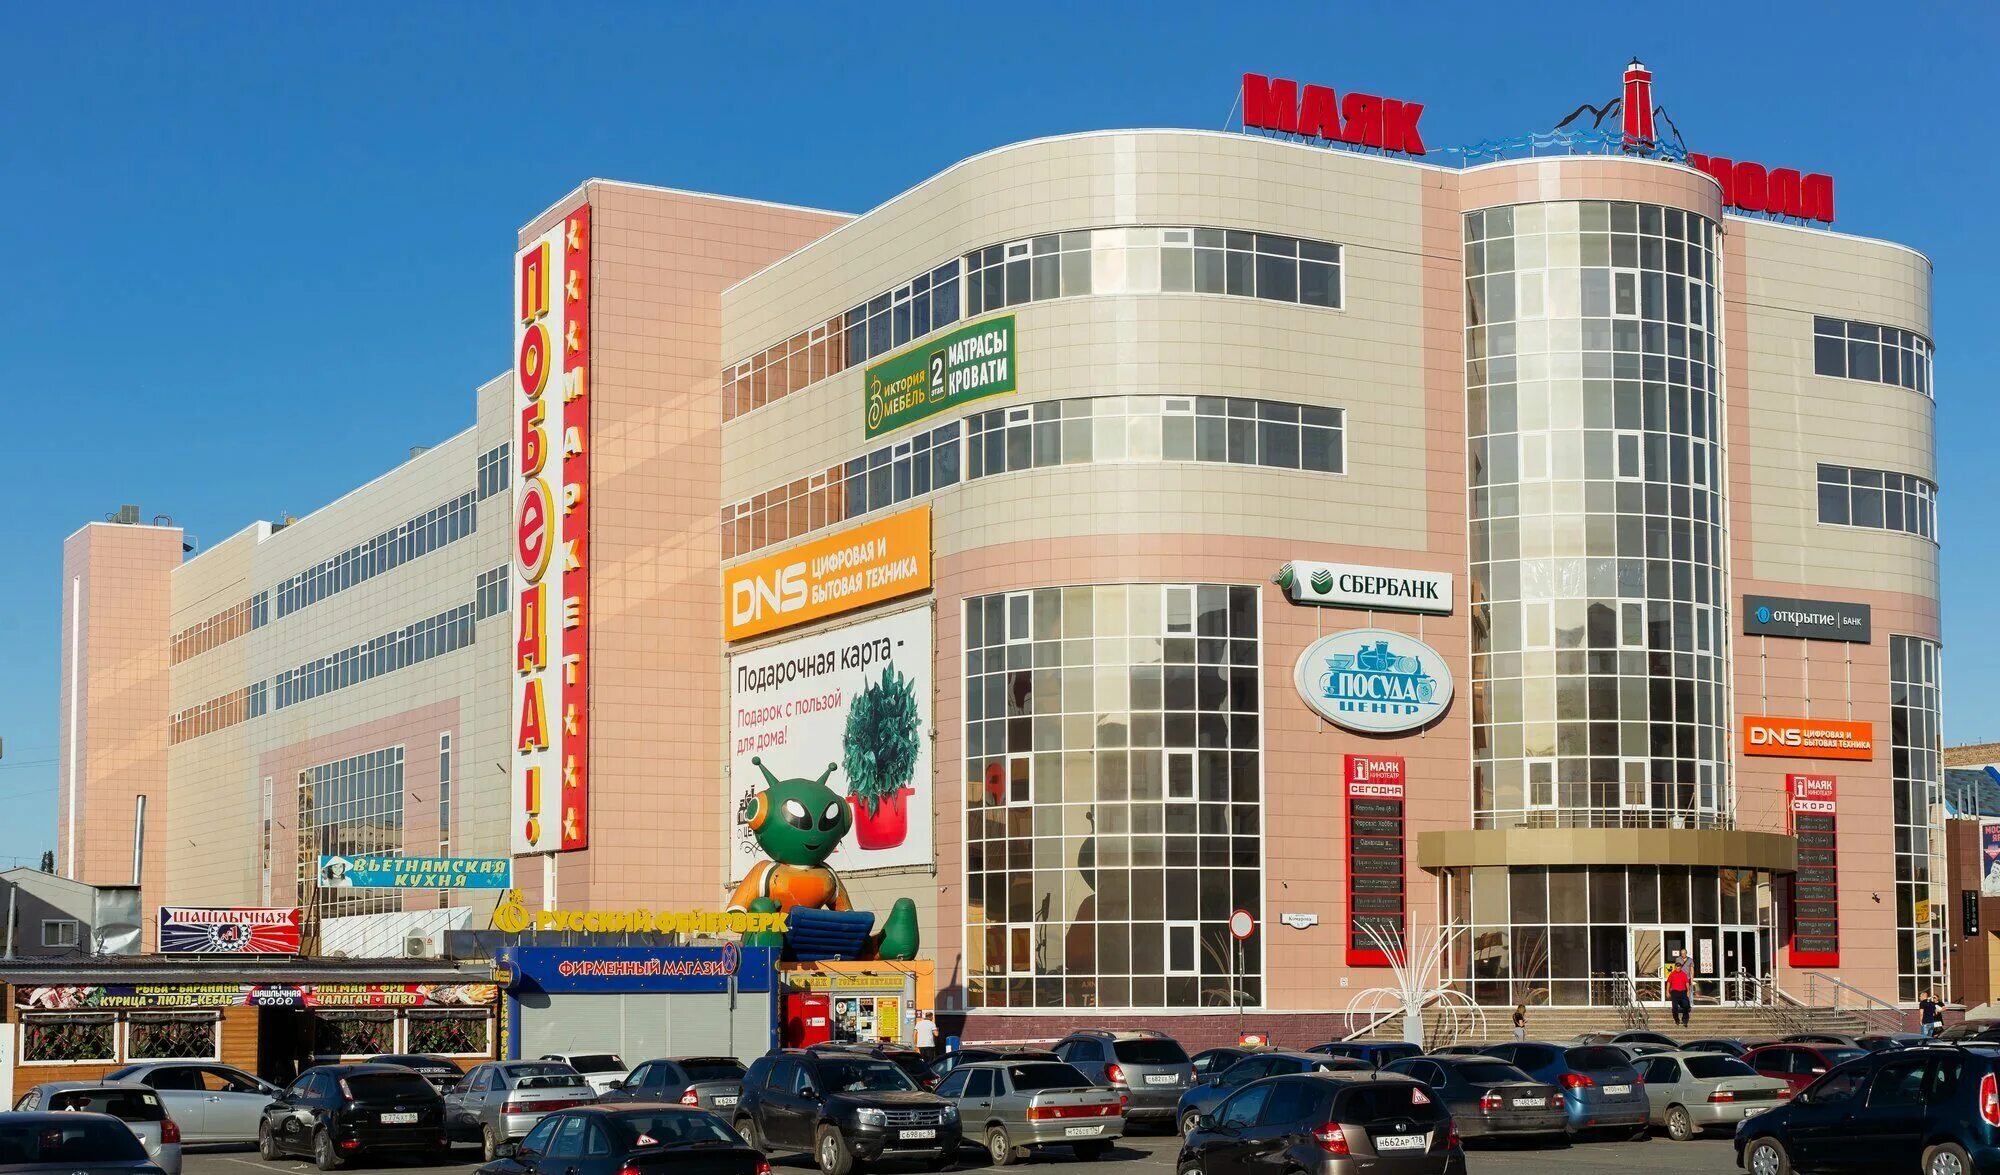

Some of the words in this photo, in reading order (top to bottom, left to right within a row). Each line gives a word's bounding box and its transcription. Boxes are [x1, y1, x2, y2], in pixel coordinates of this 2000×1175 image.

[1243, 72, 1425, 155] МАЯК
[949, 329, 1007, 367] МАТРАСЫ
[932, 358, 943, 386] 2
[949, 358, 1007, 395] КРОВАТИ
[884, 388, 926, 417] МЕБЕЛЬ
[562, 366, 585, 684] МАРКЕТ
[812, 540, 875, 579] ЦИФРОВАЯ
[878, 537, 886, 557] И
[812, 571, 863, 605] БЫТОВАЯ
[866, 556, 918, 586] ТЕХНИКА
[1339, 574, 1439, 600] СБЕРБАНК
[733, 562, 808, 627] DNS
[1773, 610, 1835, 627] открытие
[1843, 617, 1862, 626] БАНК
[738, 650, 835, 694] Подарочная
[841, 636, 891, 673] карта
[1339, 672, 1417, 701] ПОСУДА
[738, 704, 783, 729] Подарок
[785, 702, 792, 717] с
[795, 688, 842, 716] пользой
[1339, 701, 1419, 715] ЦЕНТР
[737, 736, 754, 756] для
[757, 725, 787, 752] дома!
[1750, 726, 1802, 746] DNS
[1803, 729, 1844, 739] ЦИФРОВАЯ
[1846, 731, 1852, 739] И
[1804, 738, 1838, 748] БЫТОВАЯ
[1839, 740, 1871, 750] ТЕХНИКА
[1370, 761, 1400, 772] МАЯК
[1351, 785, 1402, 795] СЕГОДНЯ
[1807, 780, 1832, 790] МАЯК
[1794, 802, 1832, 810] СКОРО
[353, 858, 506, 873] ВЬЕТНАМСКАЯ
[395, 874, 467, 887] КУХНЯ
[173, 911, 287, 923] ШАШЛЫЧНАЯ
[536, 908, 651, 934] РУССКИЙ
[655, 908, 790, 934] ФЕЙЕРВЕРК
[558, 957, 661, 977] ФИРМЕННЫЙ
[662, 960, 730, 977] МАГАЗИ
[179, 984, 240, 993] БАРАНИНА
[252, 990, 302, 999] ШАШЛЫЧНАЯ
[100, 996, 147, 1007] КУРИЦА
[157, 995, 233, 1006] ЛЮЛЯ-КЕБАБ
[316, 994, 371, 1004] ЧАЛАГАЧ
[383, 994, 417, 1004] ПИВО
